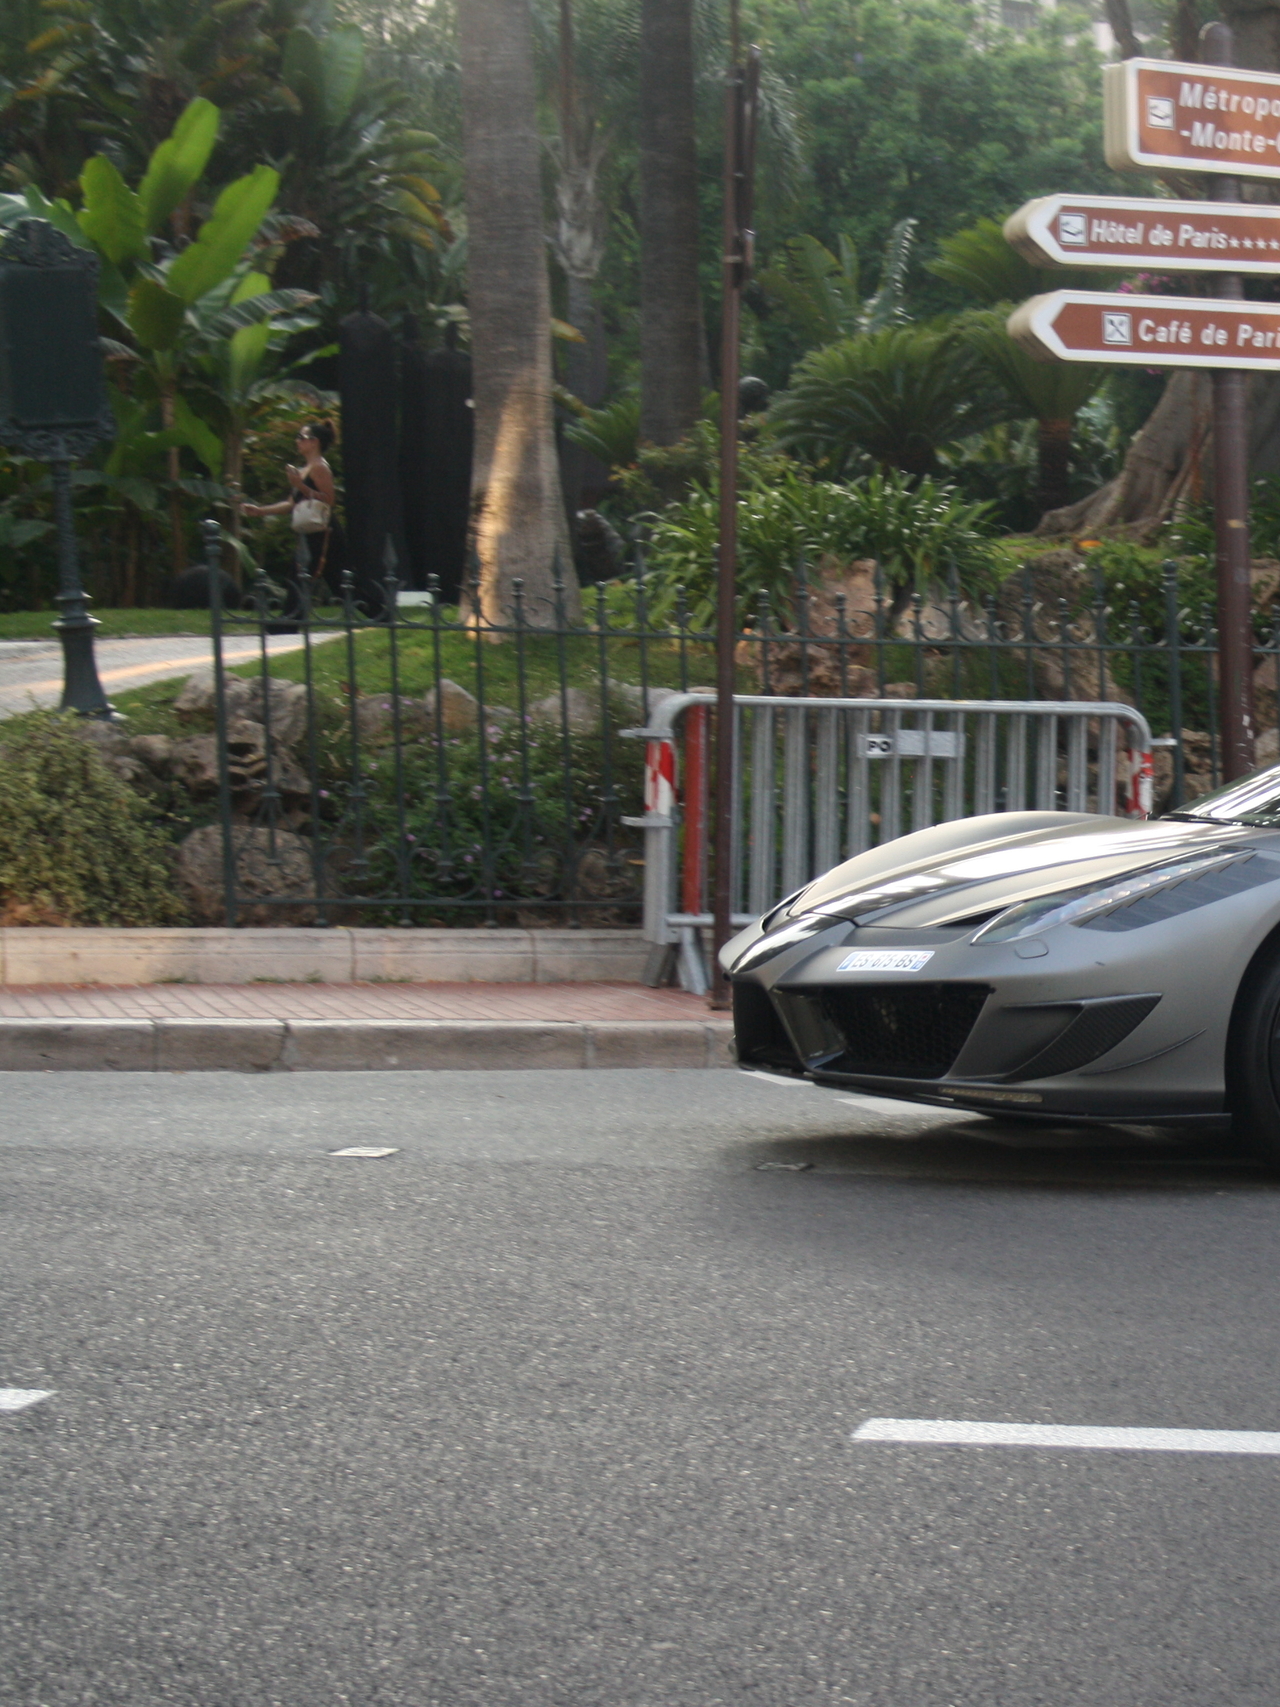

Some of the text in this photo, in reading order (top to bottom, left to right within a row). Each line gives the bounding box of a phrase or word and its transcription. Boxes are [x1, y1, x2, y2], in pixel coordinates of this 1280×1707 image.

[1090, 219, 1229, 249] Hôtel de Paris
[1138, 318, 1193, 344] Café
[1200, 323, 1229, 346] de
[851, 953, 918, 968] ES-675-BS
